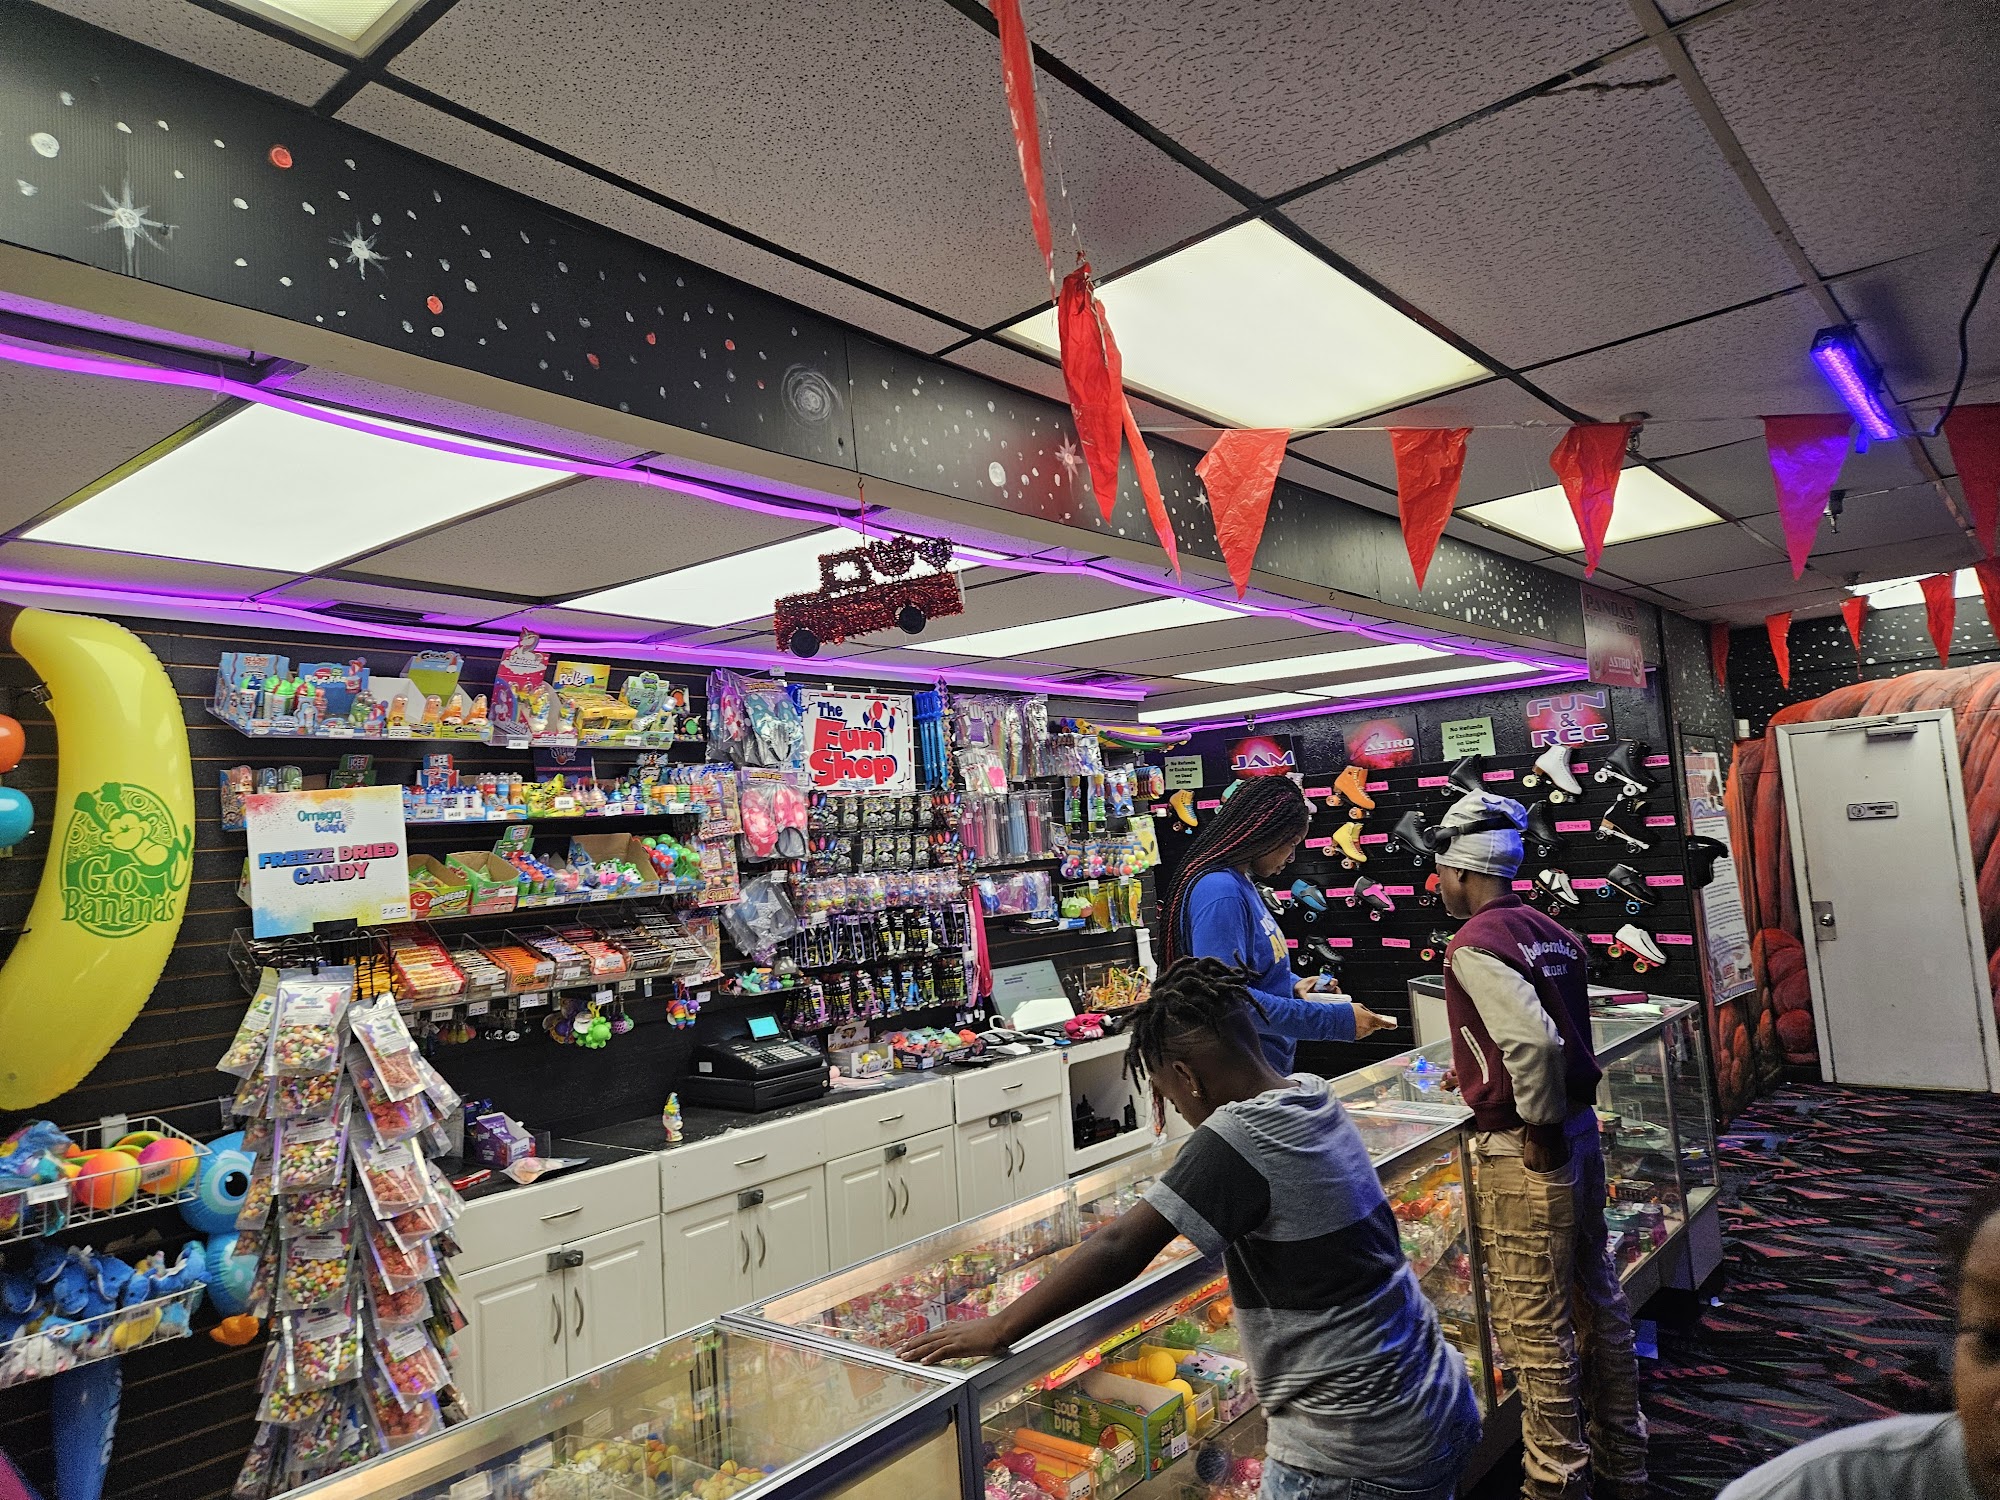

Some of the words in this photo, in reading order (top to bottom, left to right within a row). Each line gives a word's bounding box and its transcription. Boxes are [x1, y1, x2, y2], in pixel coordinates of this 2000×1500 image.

[1608, 656, 1631, 670] ASTRO
[817, 701, 843, 717] The
[1526, 691, 1606, 717] FUN
[1560, 713, 1576, 728] &
[813, 716, 885, 752] Fun
[1456, 731, 1486, 739] Exchanges
[1530, 722, 1609, 748] REC
[1364, 737, 1414, 752] ASTRO
[350, 756, 365, 768] ICEE
[808, 747, 898, 787] Shop
[1231, 750, 1295, 770] JAM
[297, 810, 342, 824] Omega
[258, 846, 335, 870] FREEZE
[338, 842, 399, 862] DRIED
[79, 854, 140, 895] Go
[292, 862, 370, 886] CANDY
[61, 886, 176, 926] Bananas
[1054, 1400, 1079, 1419] SOUR
[1054, 1415, 1080, 1436] DIPS
[1161, 1420, 1173, 1435] SOUR
[1118, 1450, 1136, 1465] $4.00
[1071, 1484, 1090, 1500] $2.00
